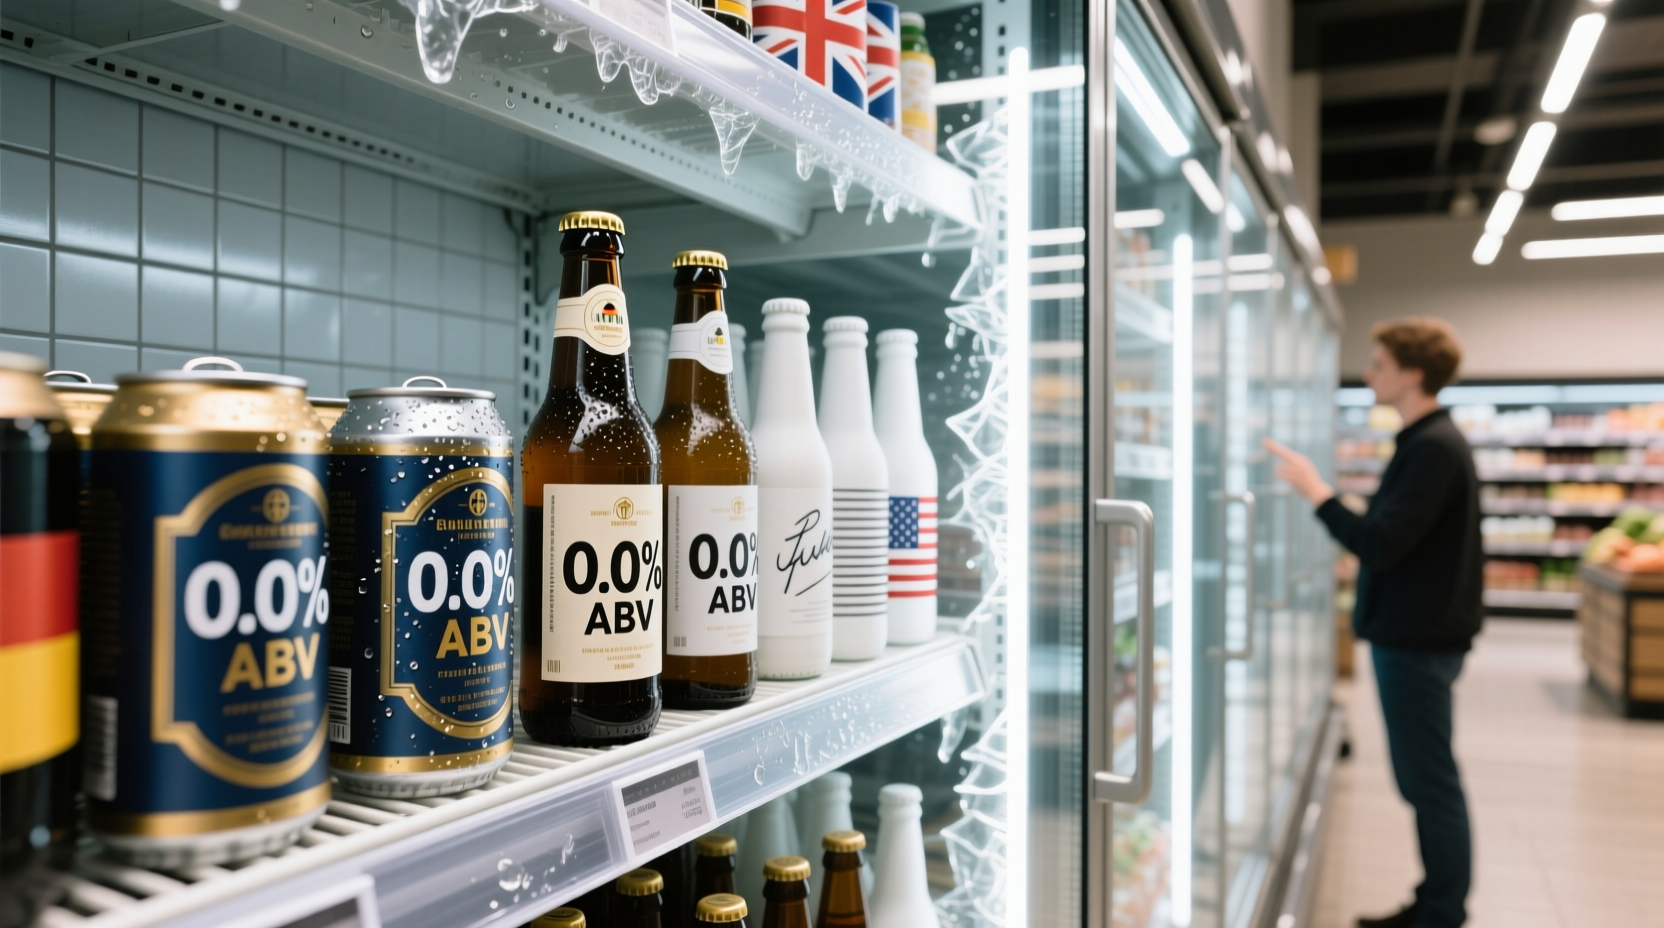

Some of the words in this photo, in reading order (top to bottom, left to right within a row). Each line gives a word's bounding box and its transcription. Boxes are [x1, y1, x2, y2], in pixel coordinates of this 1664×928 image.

[408, 548, 515, 613] 0.0%
[563, 540, 662, 594] 0.0%
[689, 532, 758, 580] 0.0%
[184, 555, 329, 640] 0.0%
[584, 599, 654, 635] ABV
[708, 582, 757, 614] ABV
[436, 612, 509, 659] ABV
[219, 632, 320, 693] ABV
